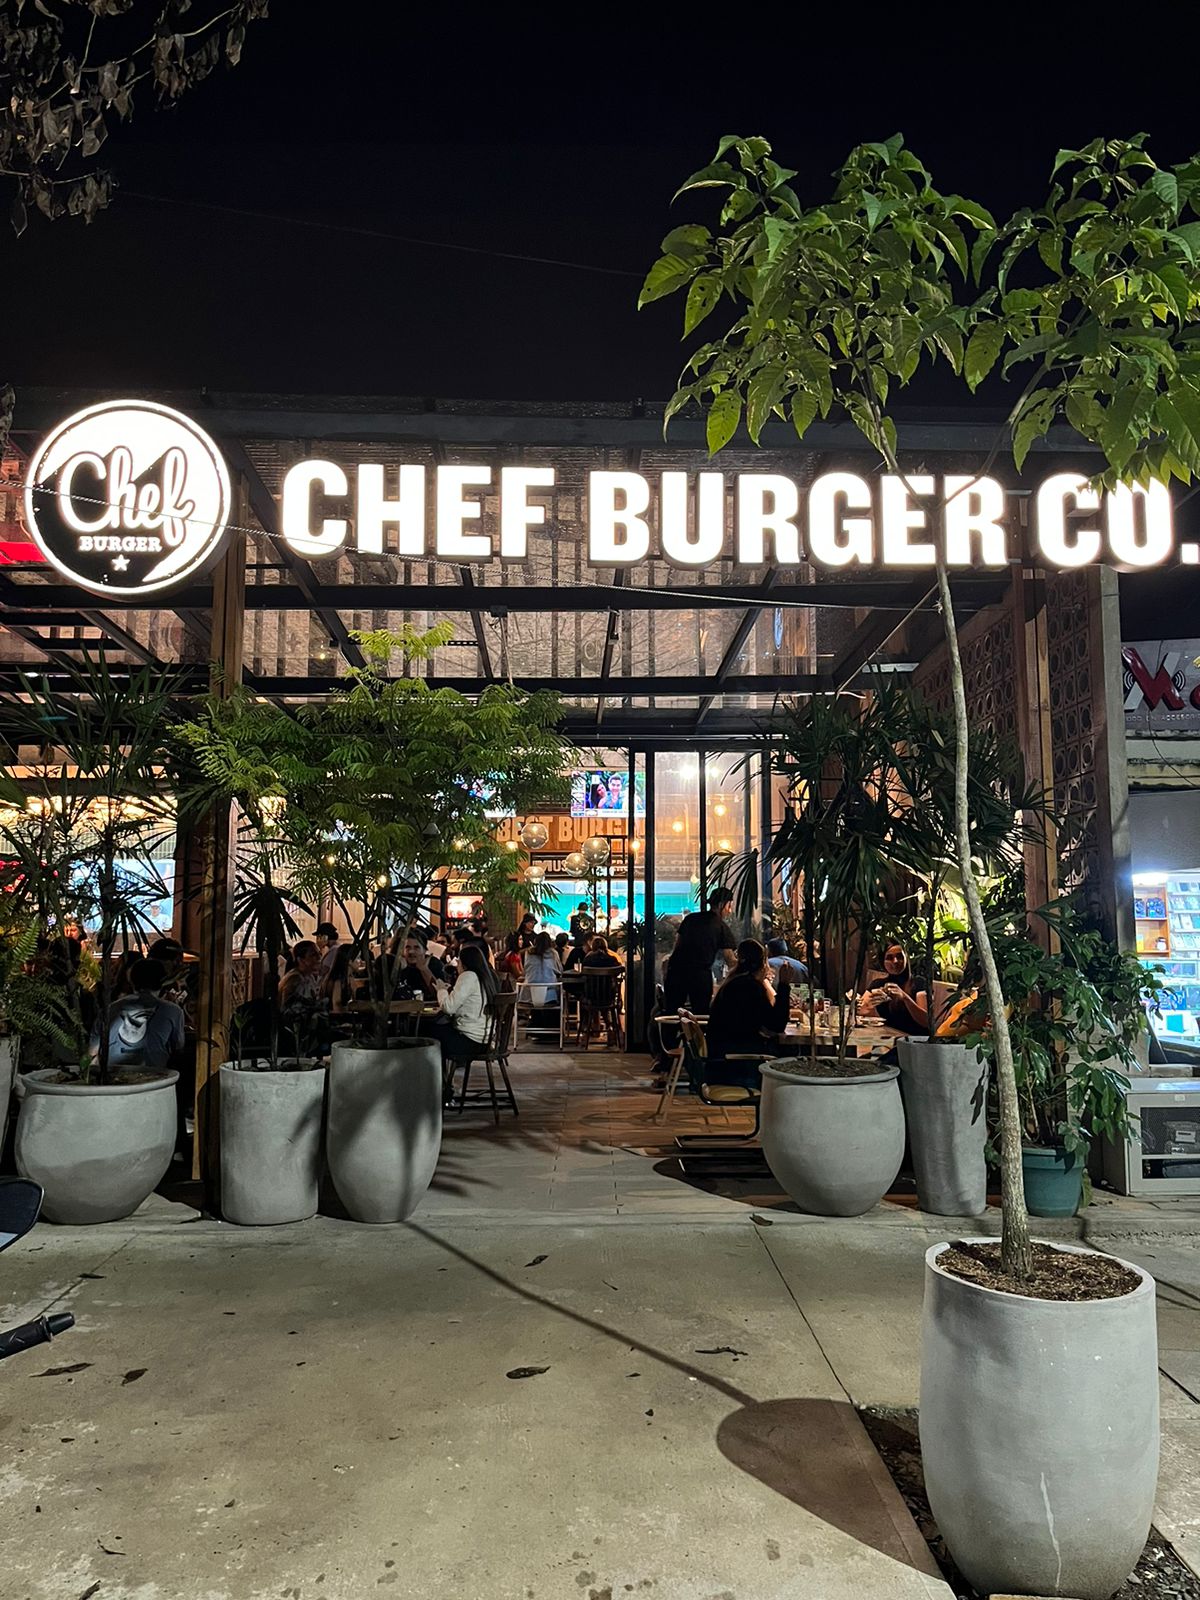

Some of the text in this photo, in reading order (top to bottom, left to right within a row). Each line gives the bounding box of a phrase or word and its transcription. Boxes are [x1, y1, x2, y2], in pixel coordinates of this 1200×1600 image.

[58, 445, 195, 547] Chef
[78, 535, 162, 553] BURGER
[282, 460, 1199, 567] CHEF BURGER CO.
